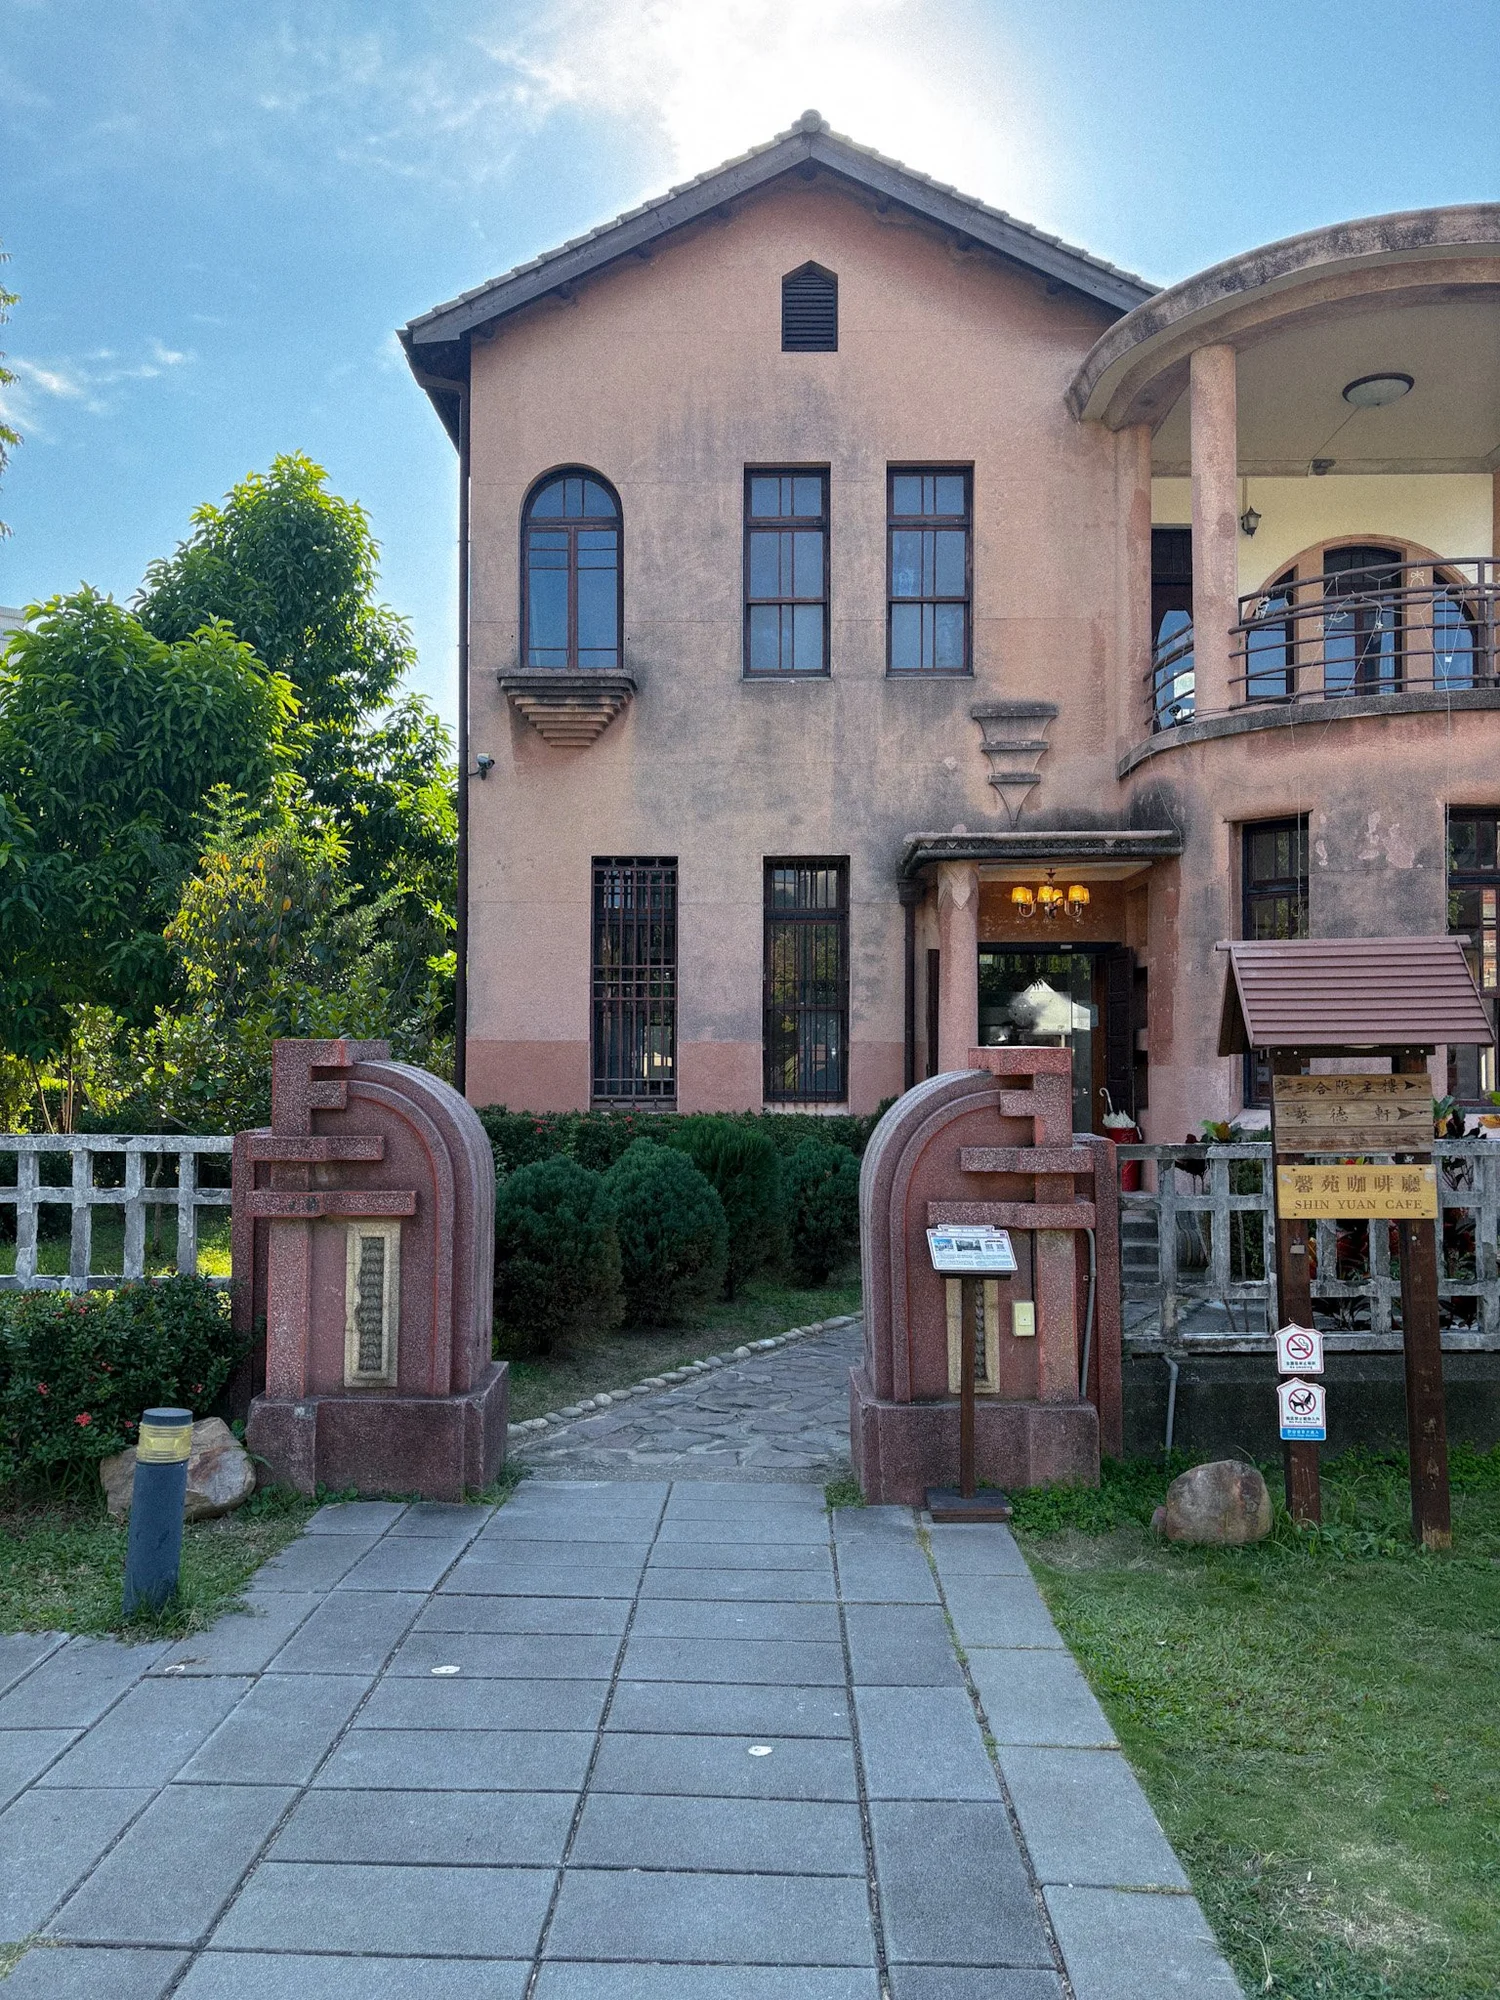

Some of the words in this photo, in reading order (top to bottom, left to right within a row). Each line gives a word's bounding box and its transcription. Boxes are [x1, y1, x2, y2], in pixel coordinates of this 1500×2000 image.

[1294, 1174, 1421, 1193] 馨苑咖啡廳
[1294, 1199, 1329, 1210] SHIN
[1338, 1199, 1377, 1210] YUAN
[1385, 1199, 1423, 1210] CAFE
